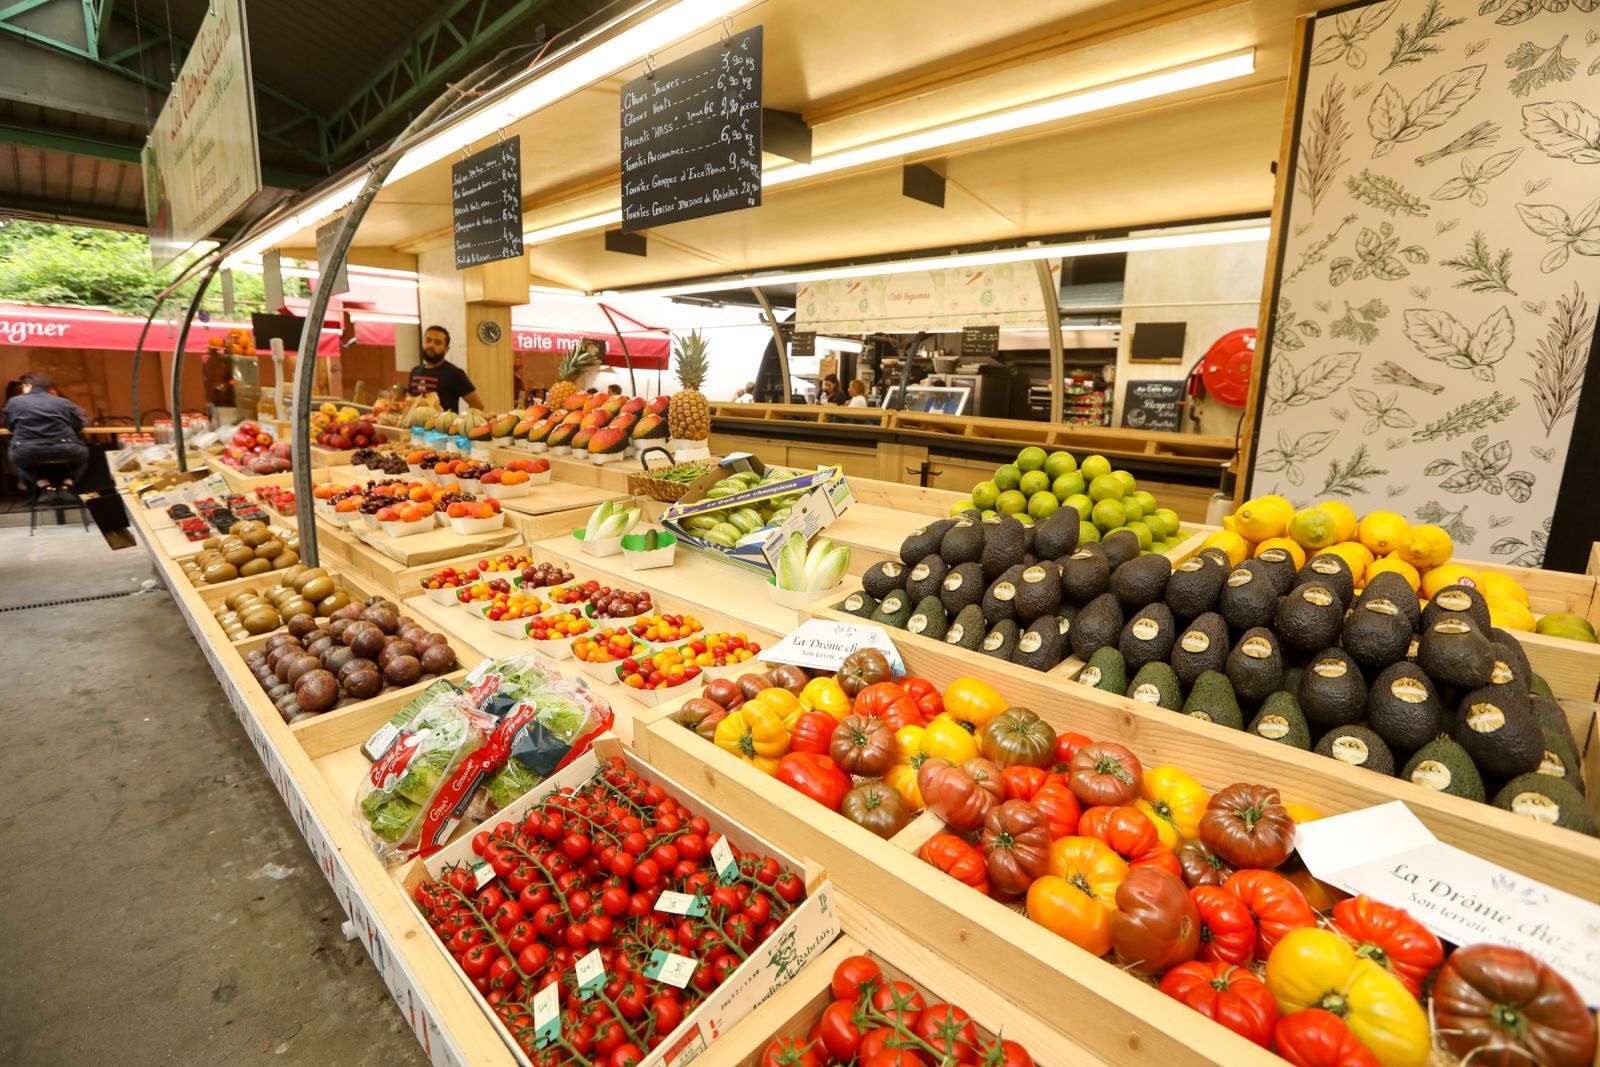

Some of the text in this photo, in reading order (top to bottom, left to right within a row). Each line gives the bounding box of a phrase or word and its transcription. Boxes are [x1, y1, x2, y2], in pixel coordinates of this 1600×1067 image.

[517, 333, 552, 350] faite
[752, 482, 798, 497] champions
[792, 635, 806, 647] La
[1389, 863, 1418, 886] La
[1428, 877, 1512, 926] Drôme
